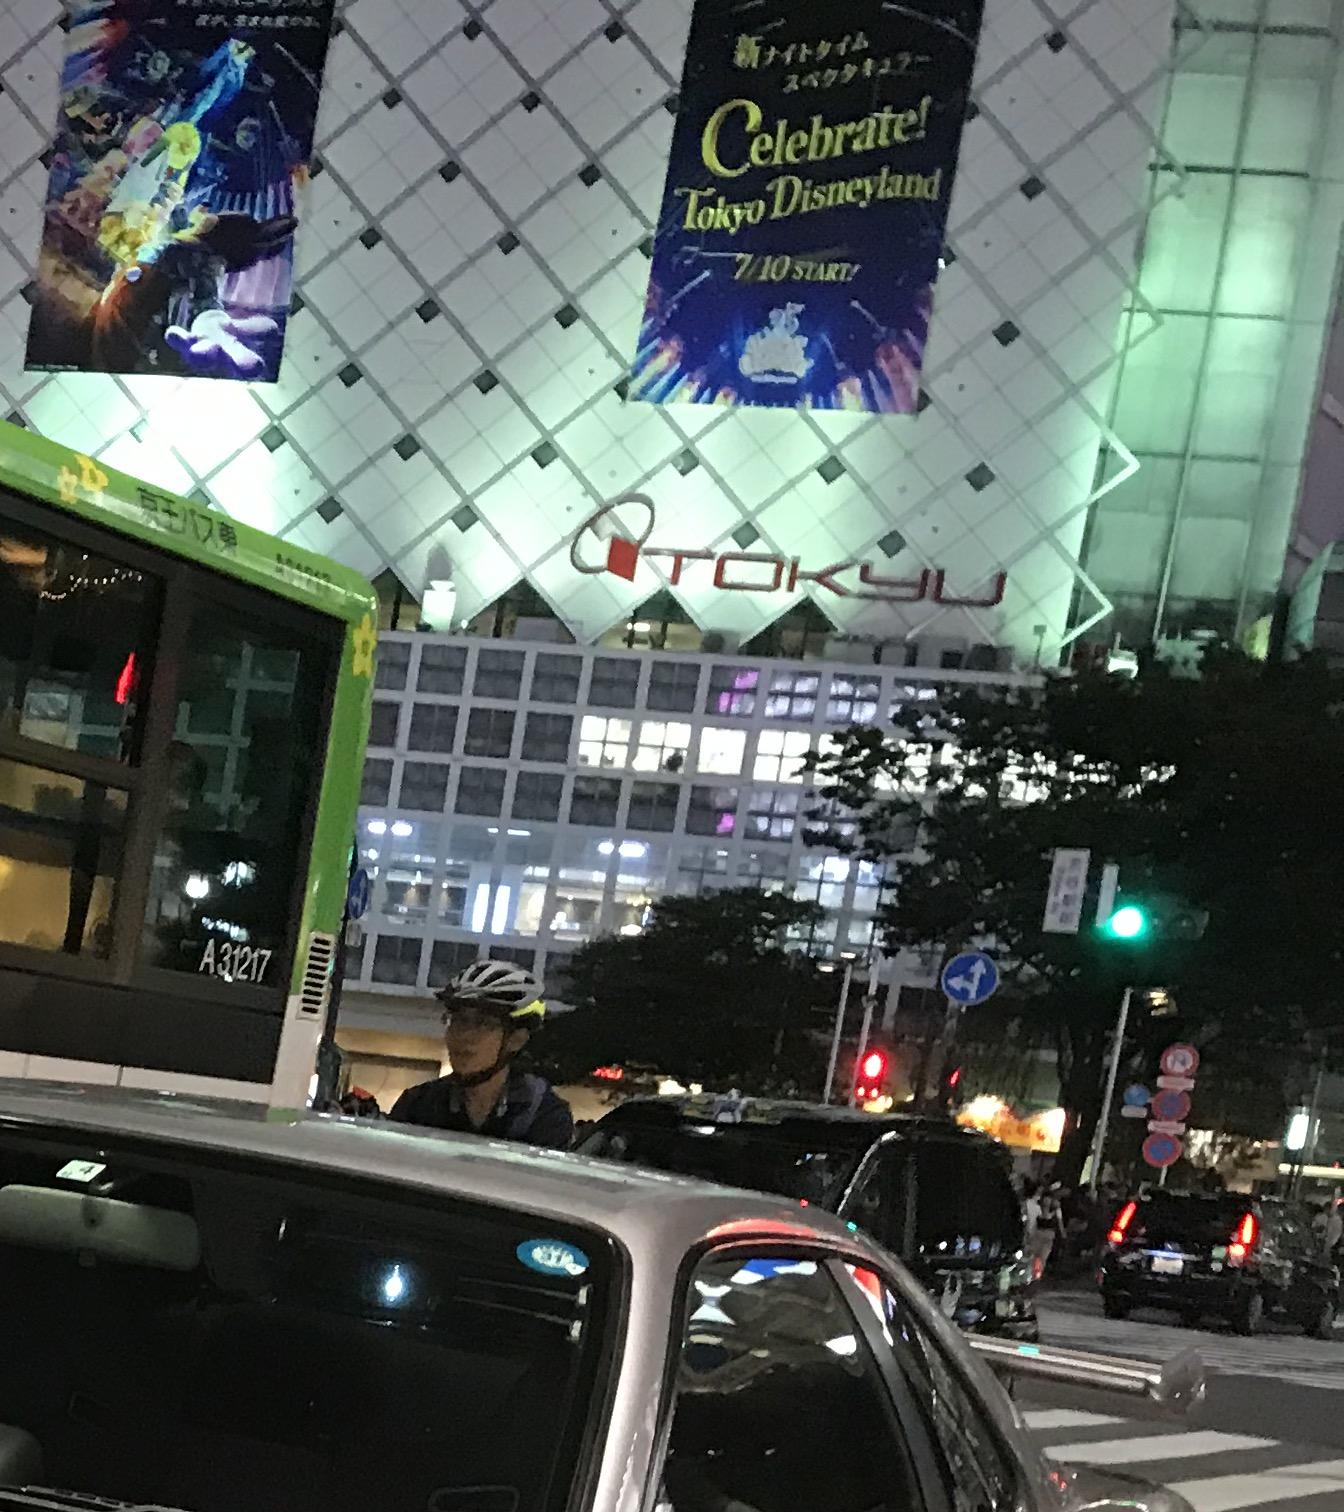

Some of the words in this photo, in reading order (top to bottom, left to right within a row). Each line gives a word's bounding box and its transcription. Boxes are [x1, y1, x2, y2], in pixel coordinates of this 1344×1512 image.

[701, 94, 932, 178] Celebrate!
[674, 186, 765, 235] Tokyo
[766, 164, 942, 220] Disneyland
[734, 253, 791, 281] 7/10
[792, 262, 862, 281] START!
[641, 547, 1007, 608] TOKYU
[198, 938, 272, 983] A31217
